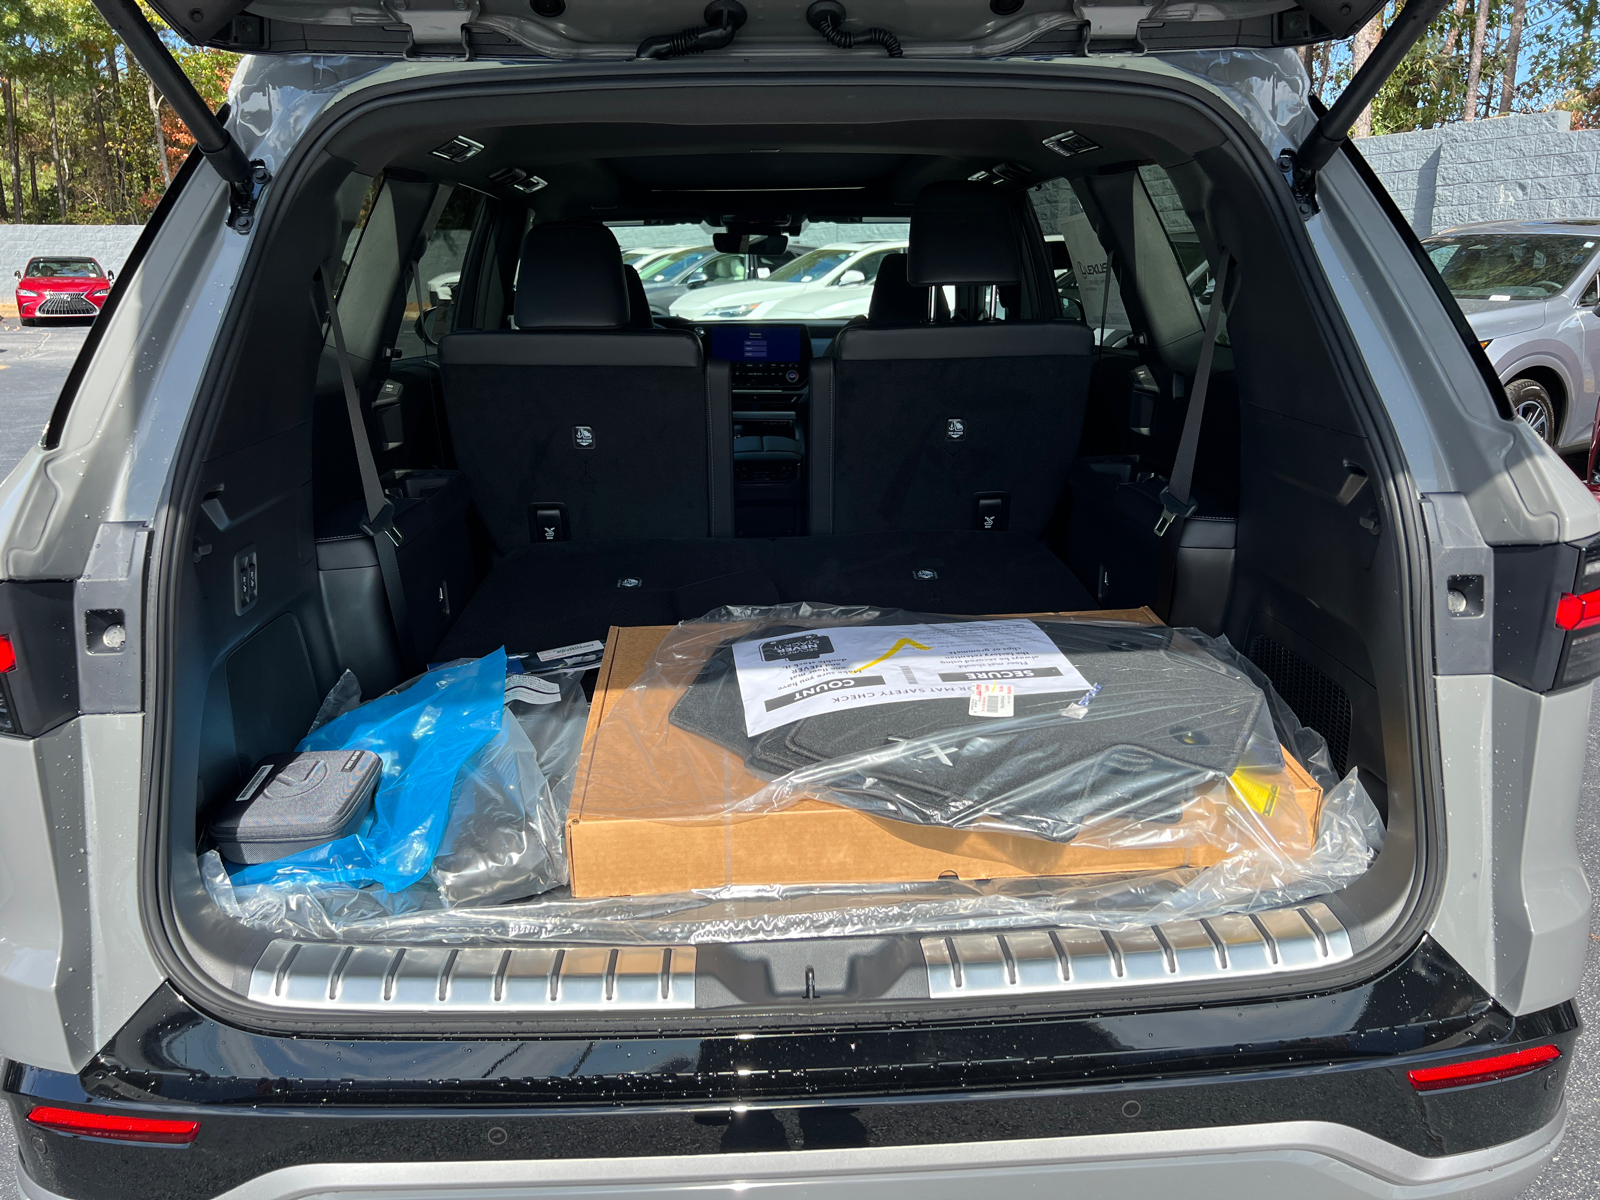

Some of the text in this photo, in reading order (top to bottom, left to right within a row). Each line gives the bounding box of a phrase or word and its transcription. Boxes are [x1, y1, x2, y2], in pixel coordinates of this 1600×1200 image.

[792, 664, 822, 674] NEVER
[965, 670, 1034, 680] SECURE
[778, 682, 798, 691] have
[793, 679, 855, 700] COUNT
[879, 688, 925, 696] SAFETY
[831, 692, 875, 704] CHECK
